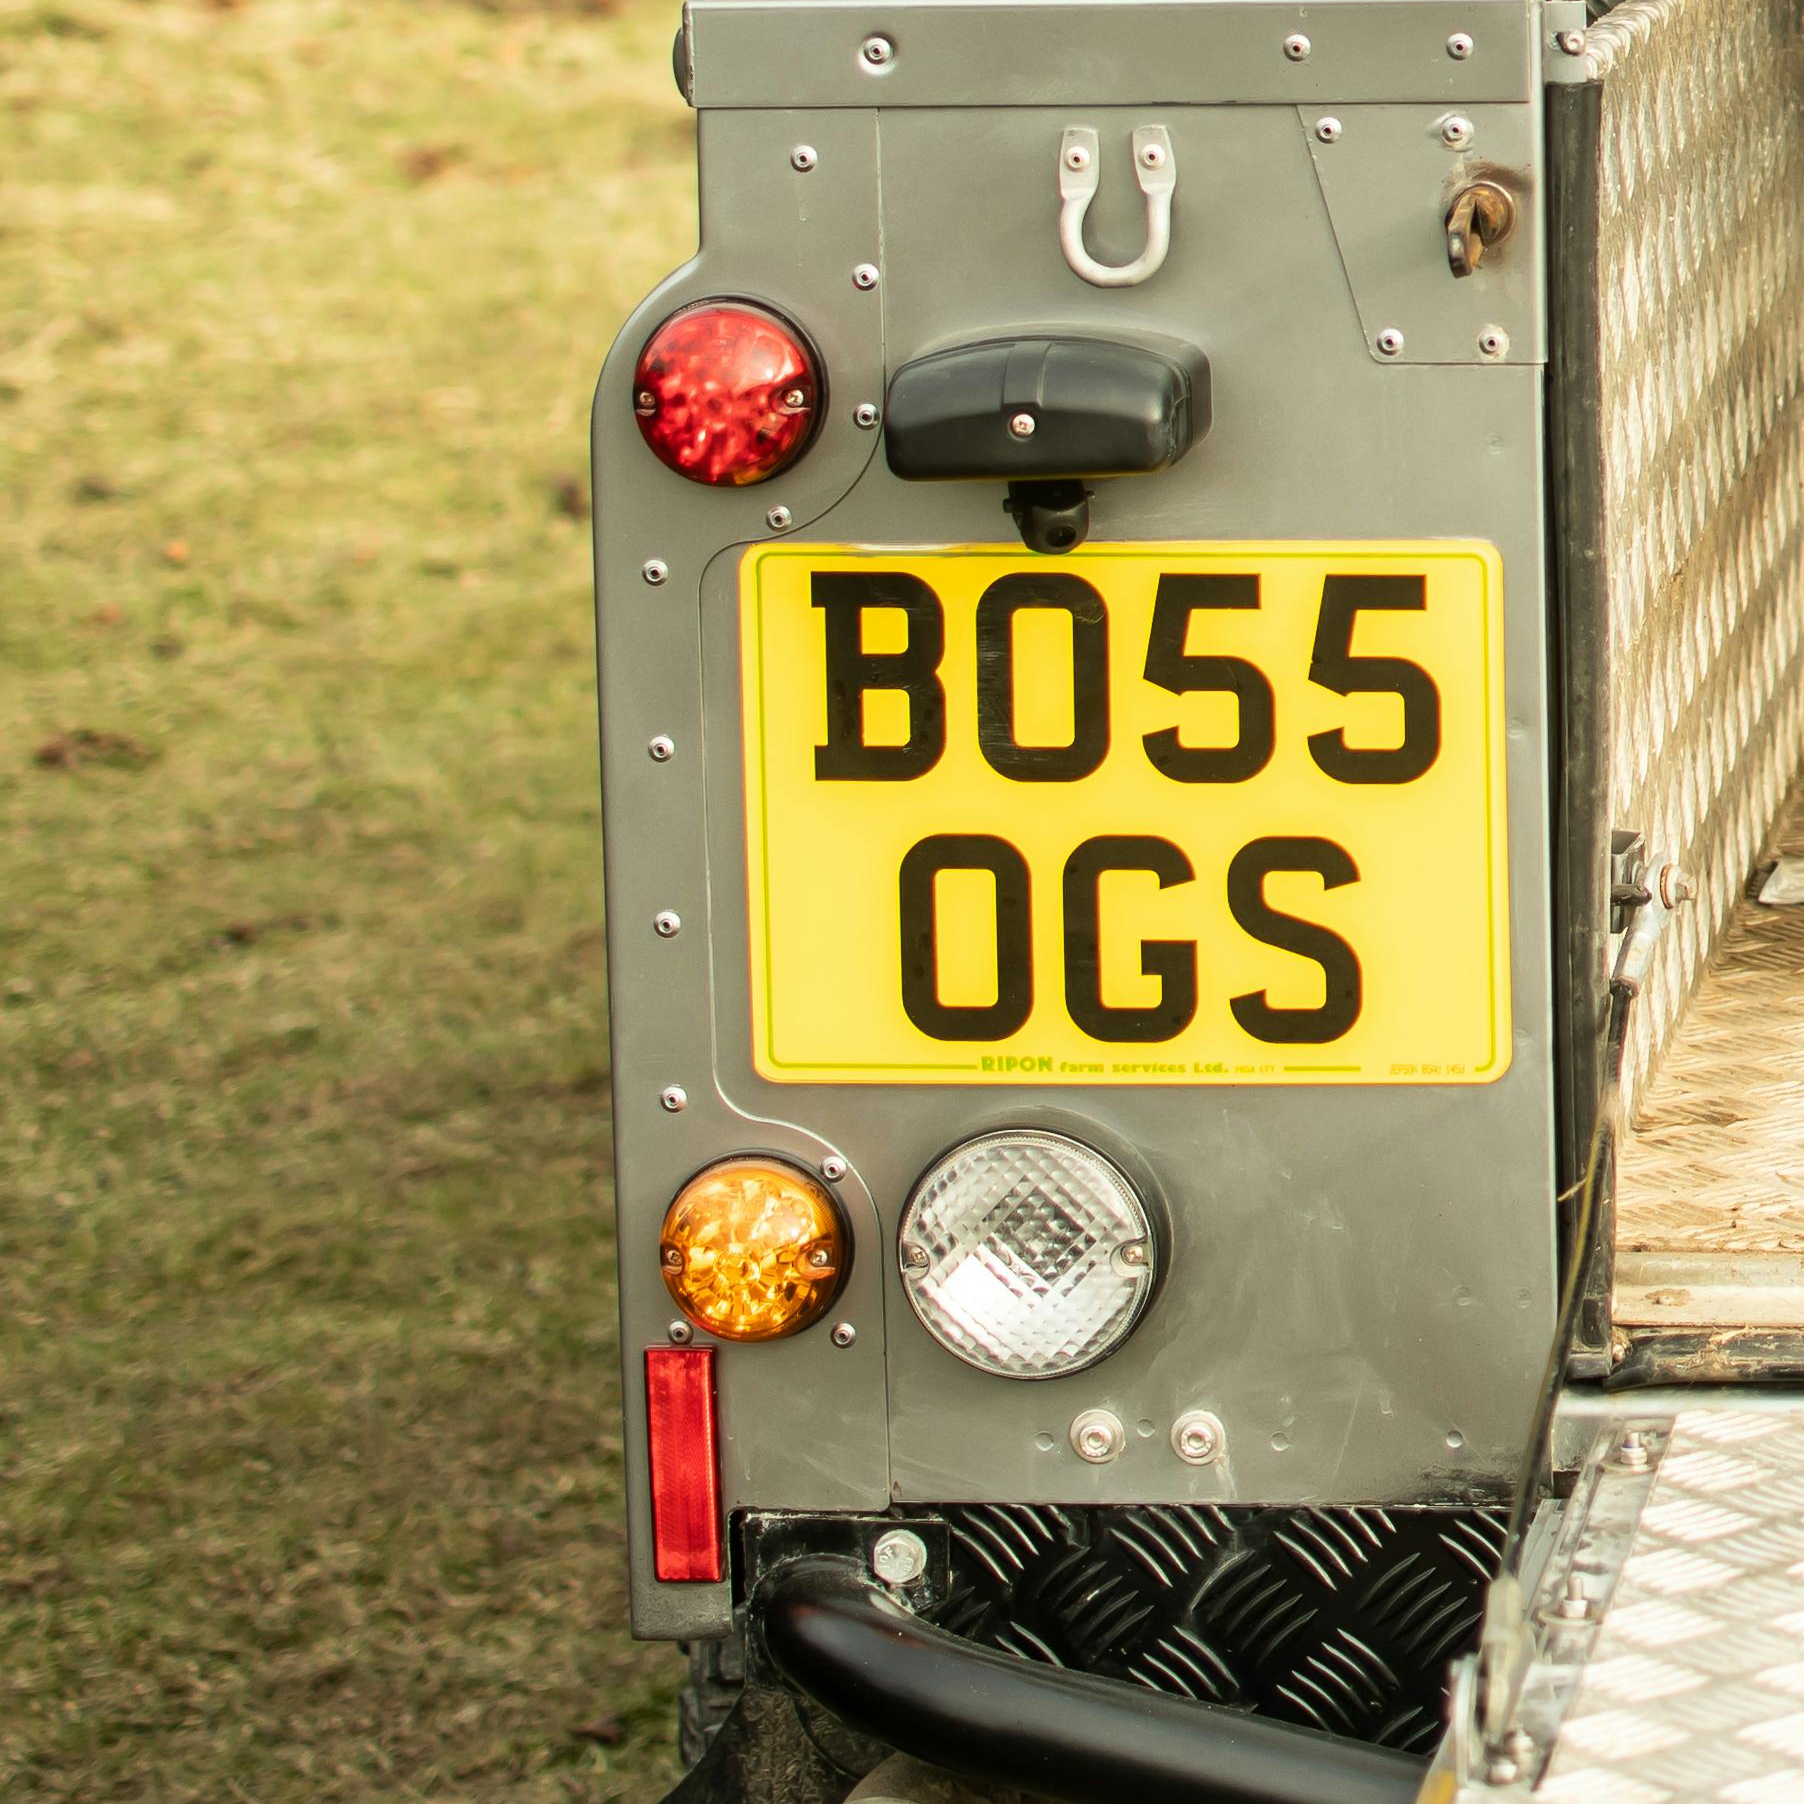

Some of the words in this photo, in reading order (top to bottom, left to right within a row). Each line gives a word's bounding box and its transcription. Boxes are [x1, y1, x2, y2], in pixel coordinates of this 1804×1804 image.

[811, 571, 1441, 784] BO55
[899, 833, 1364, 1044] OGS
[981, 1056, 1053, 1072] RIPON
[1060, 1062, 1104, 1073] farm
[1112, 1062, 1186, 1073] services
[1194, 1062, 1229, 1073] Ltd.
